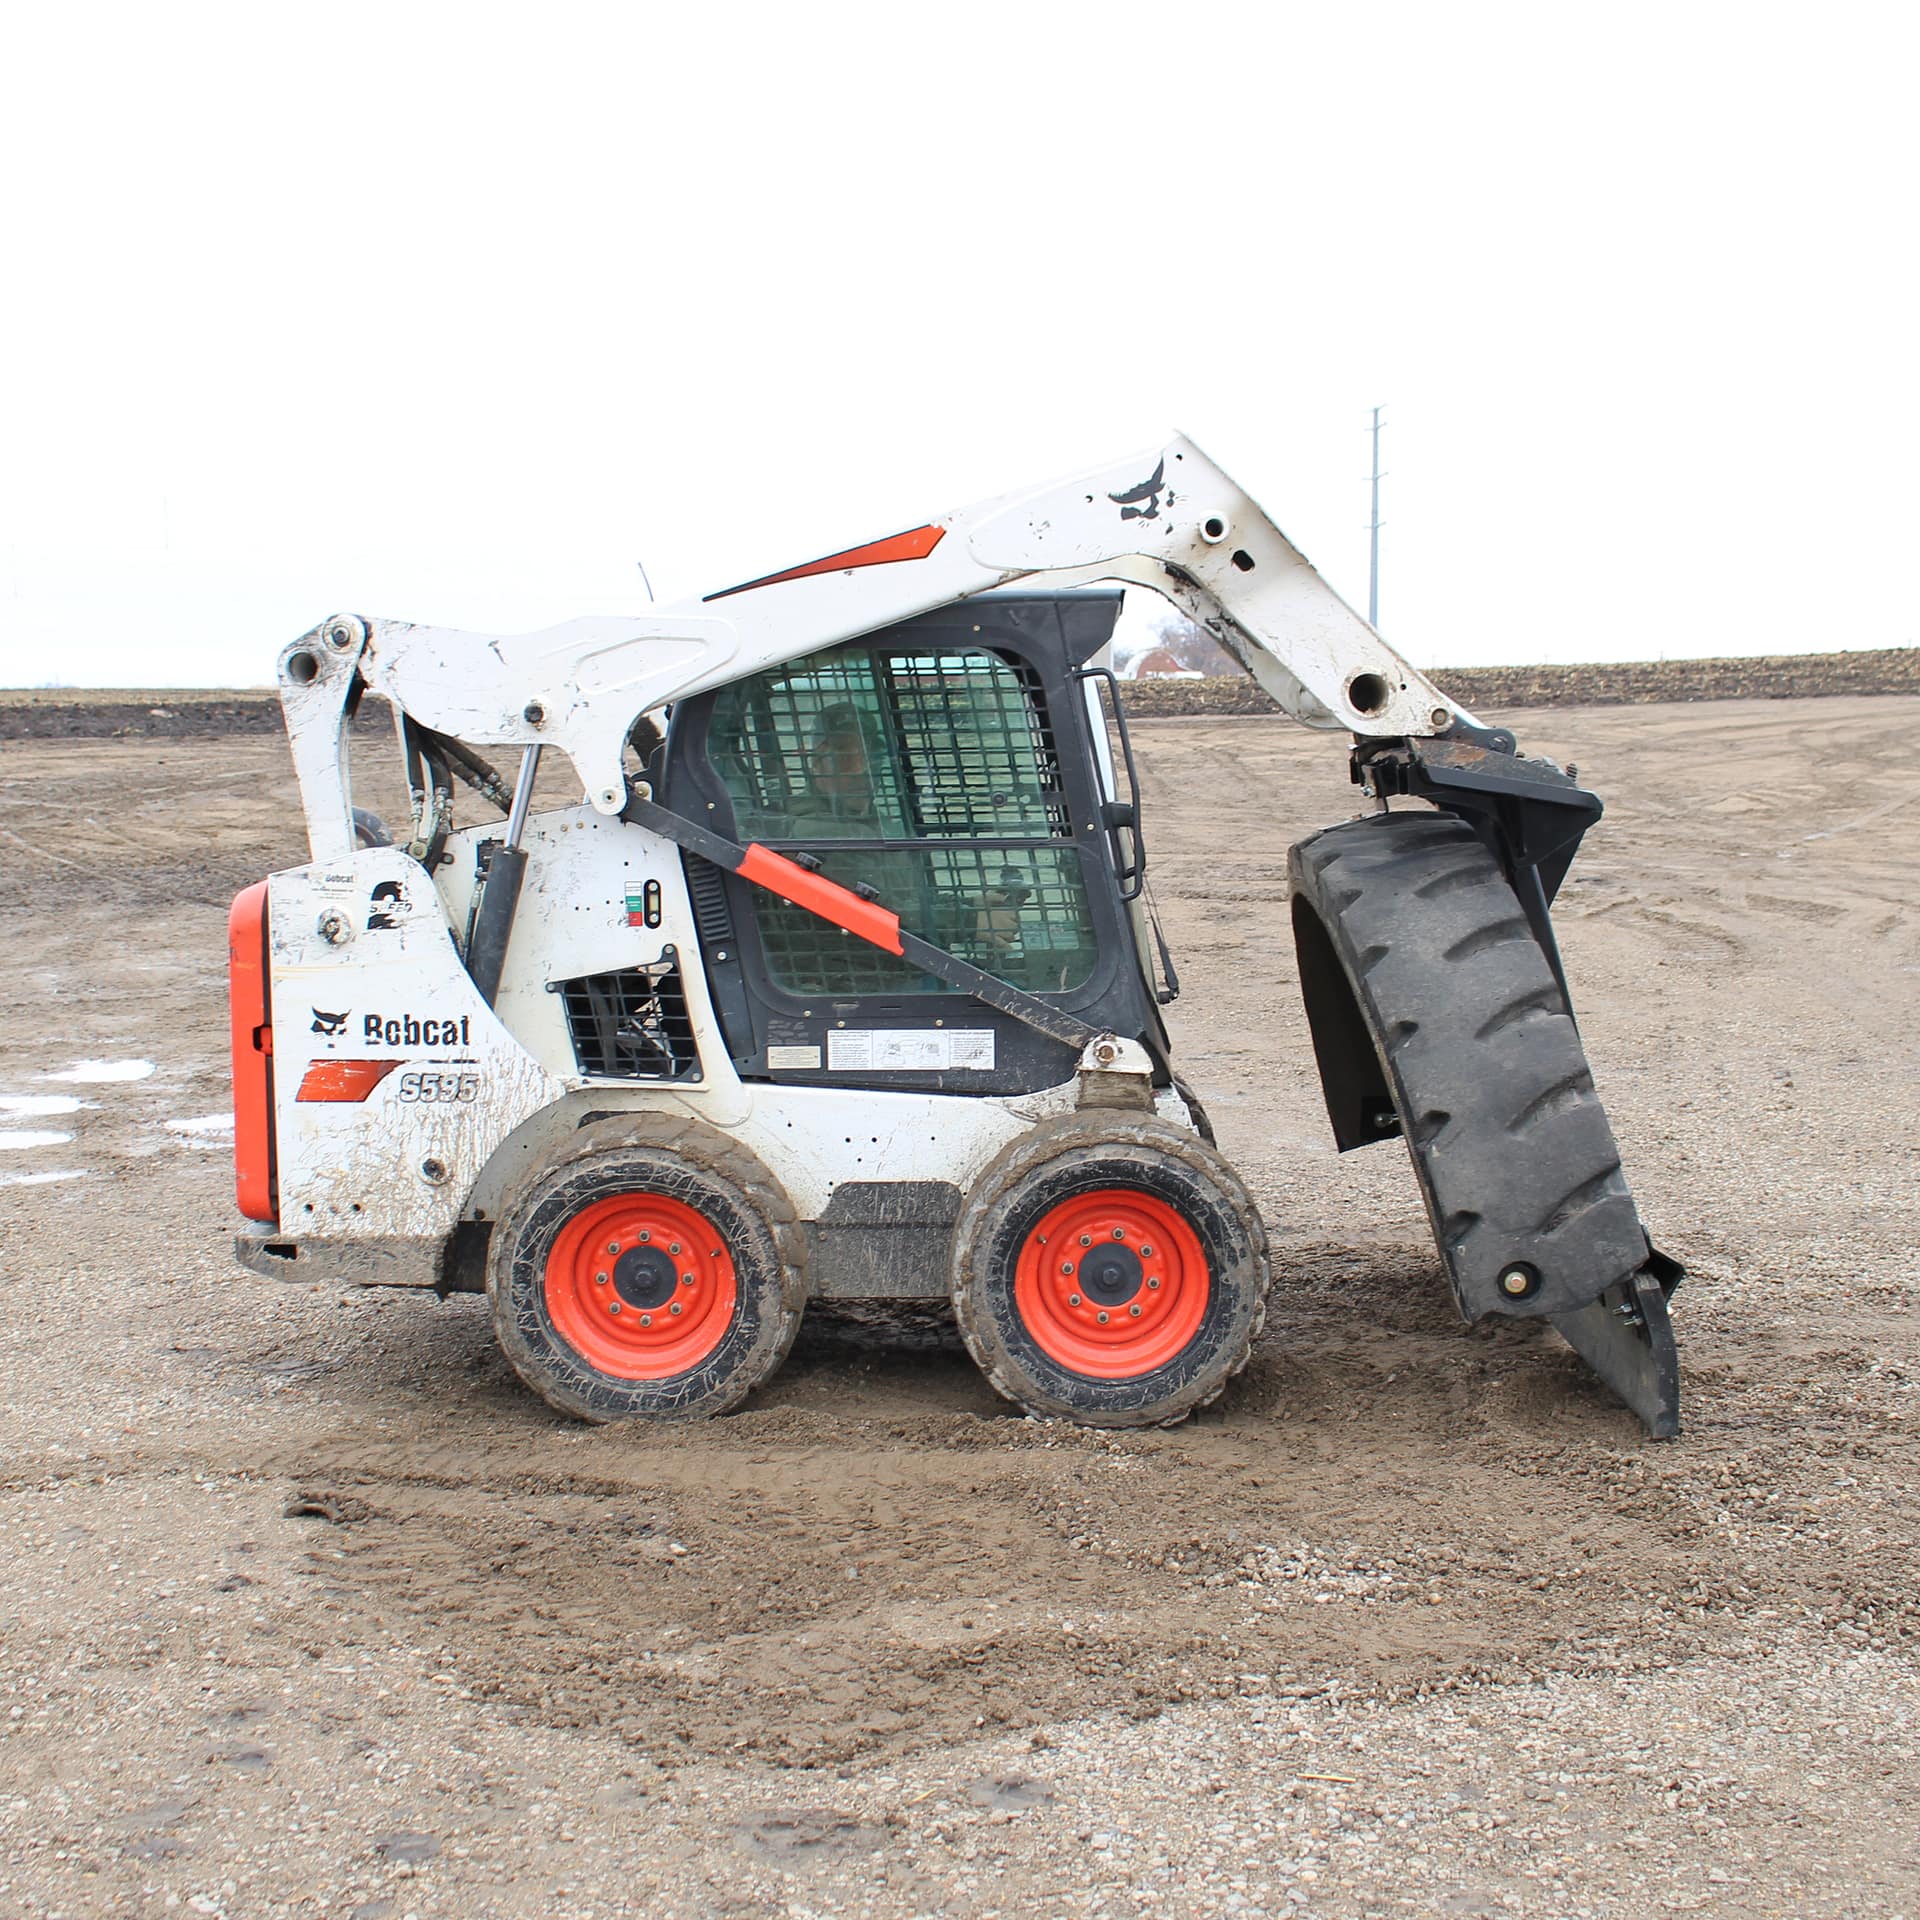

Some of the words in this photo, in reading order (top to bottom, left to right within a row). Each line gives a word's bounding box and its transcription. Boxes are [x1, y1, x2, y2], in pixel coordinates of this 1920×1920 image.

[369, 902, 413, 913] SEED
[364, 1014, 470, 1046] Bobcat
[400, 1072, 481, 1103] S595
